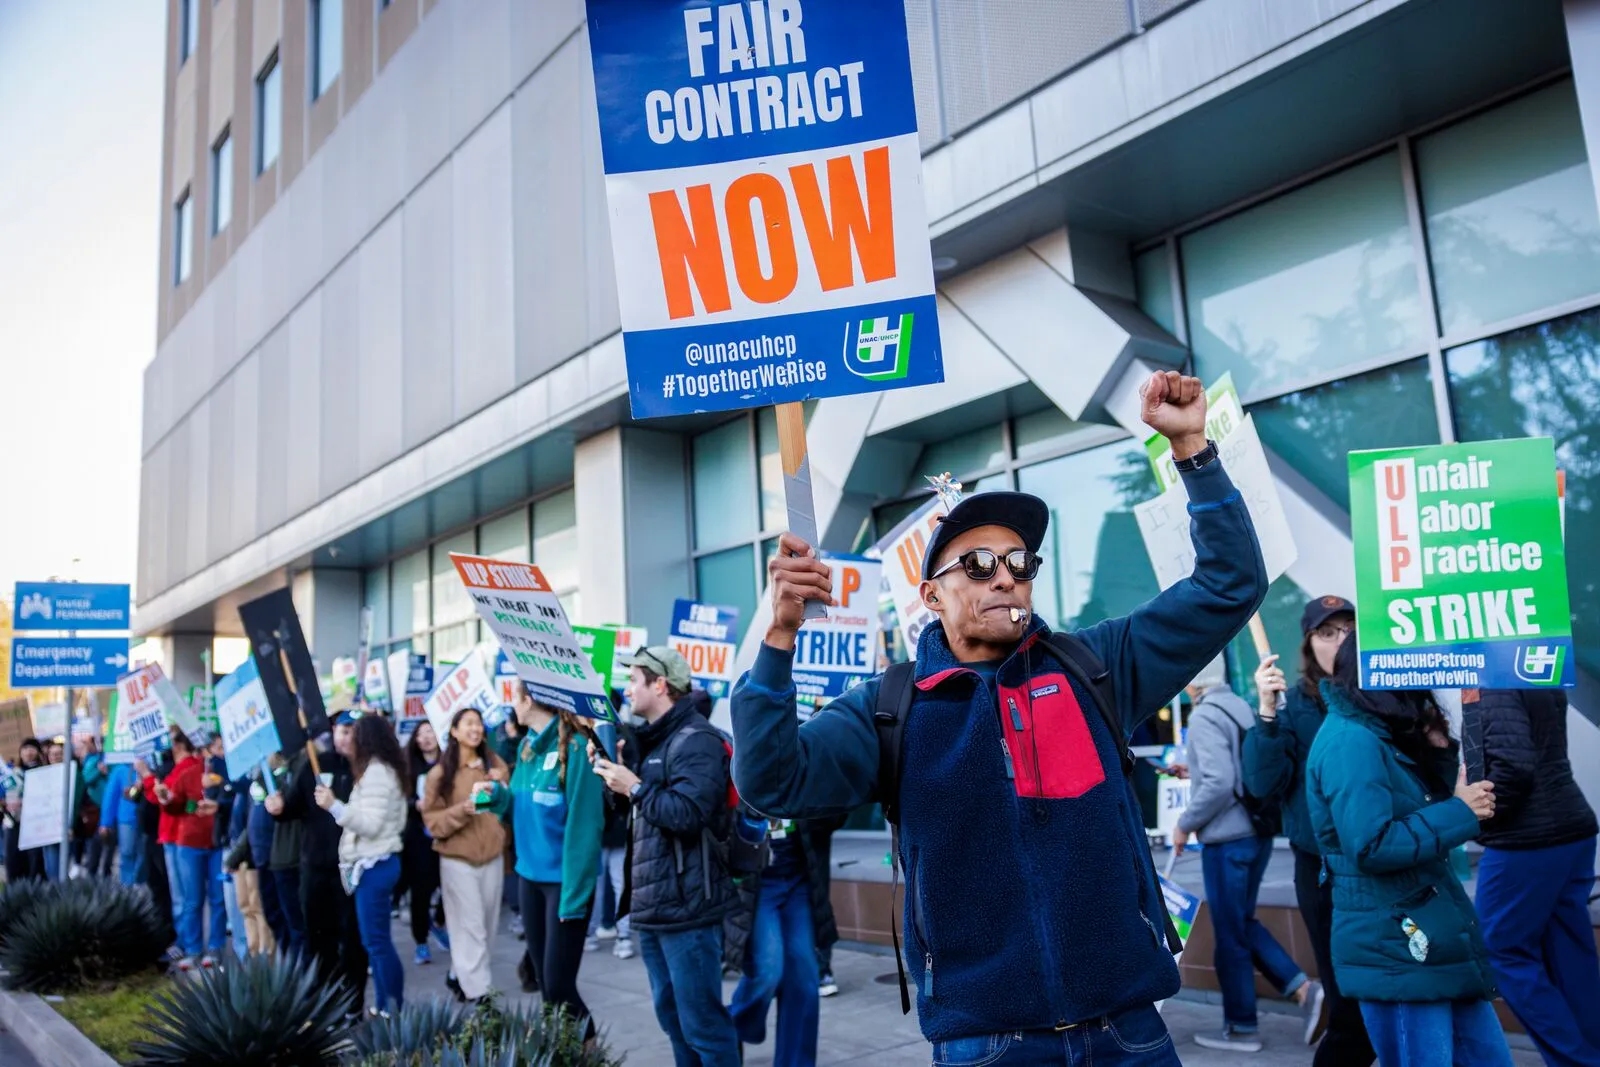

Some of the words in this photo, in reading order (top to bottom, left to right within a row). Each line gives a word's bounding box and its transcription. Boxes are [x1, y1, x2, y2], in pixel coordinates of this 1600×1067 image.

[683, 0, 807, 77] FAIR
[645, 61, 865, 145] CONTRACT
[648, 146, 897, 320] NOW
[685, 333, 797, 367] @unacuhcp
[662, 359, 828, 398] #TogetherWeRise
[461, 562, 490, 586] ULP
[488, 565, 542, 589] STRIKE
[1388, 588, 1541, 645] STRIKE
[16, 644, 93, 662] Emergency
[796, 630, 867, 667] TRIKE
[1369, 653, 1486, 669] #UNACUHCPstrong
[15, 662, 95, 679] Department
[1370, 671, 1479, 688] #TogetherWeWin
[436, 668, 470, 712] ULP
